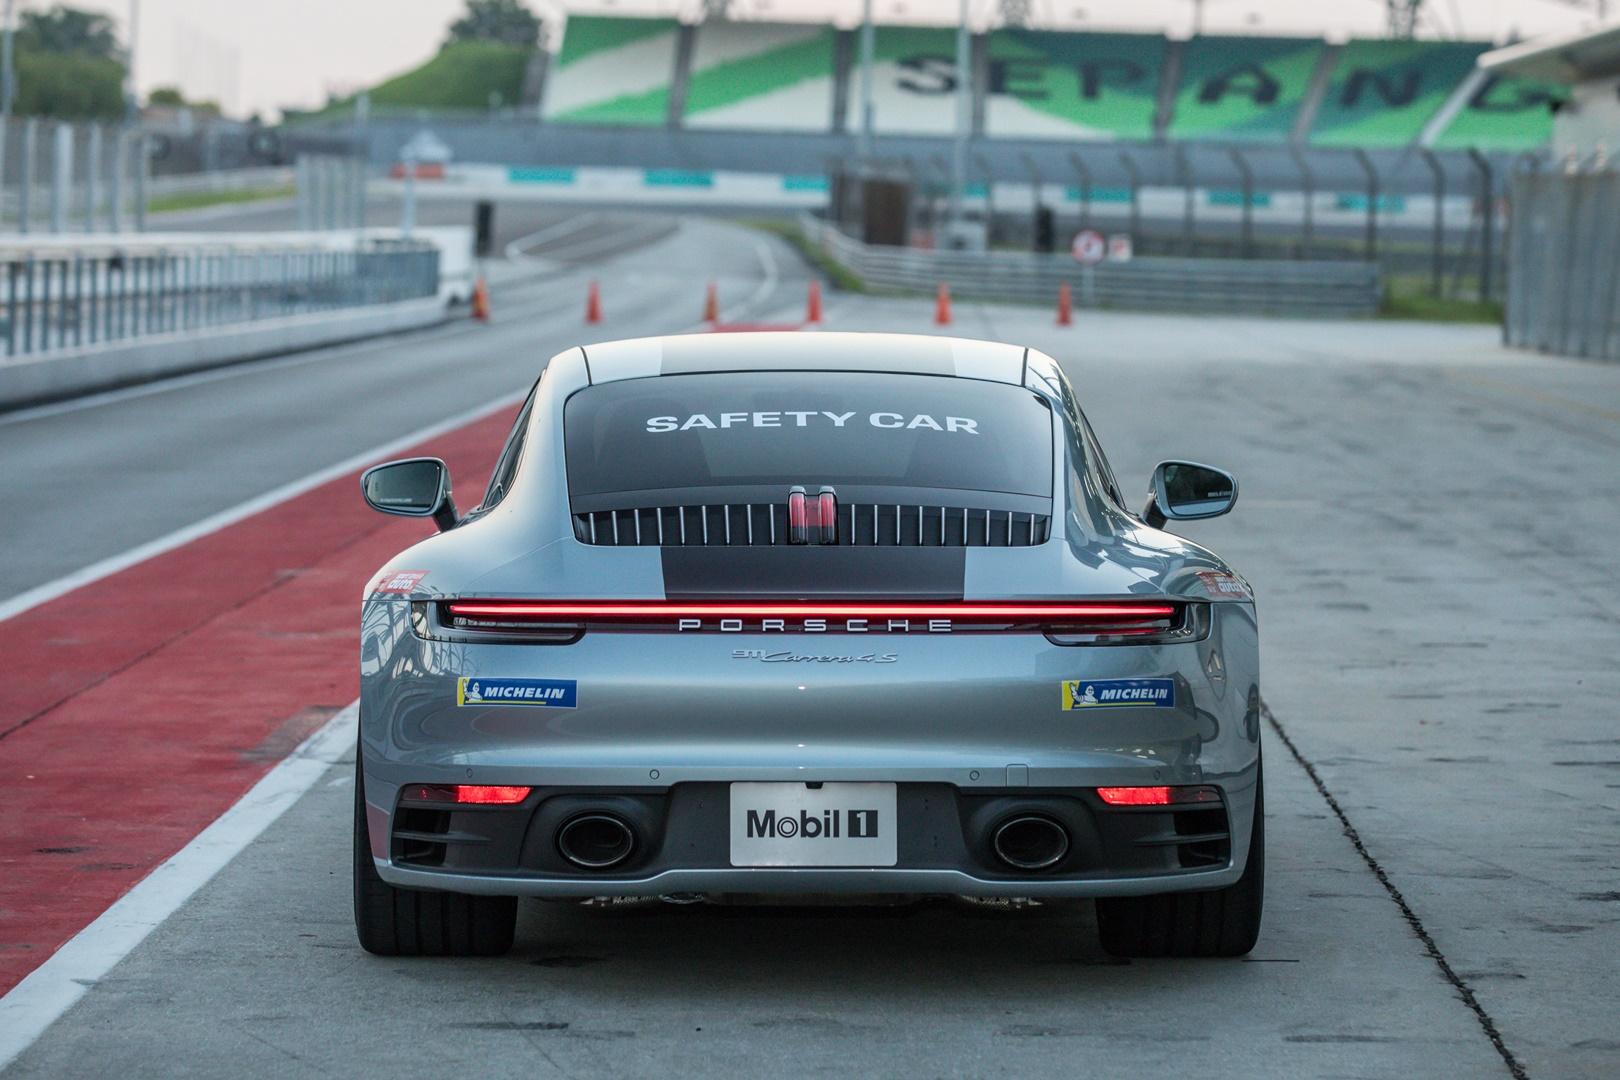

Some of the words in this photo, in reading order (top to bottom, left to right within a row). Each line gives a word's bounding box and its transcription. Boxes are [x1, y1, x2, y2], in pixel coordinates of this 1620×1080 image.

[646, 411, 857, 433] SAFETY
[869, 412, 979, 435] CAR
[678, 618, 952, 632] PORSCHE
[760, 650, 854, 663] Carrera
[484, 686, 565, 699] MICHELIN
[1100, 688, 1168, 700] MICHELIN
[747, 809, 839, 838] Mobil
